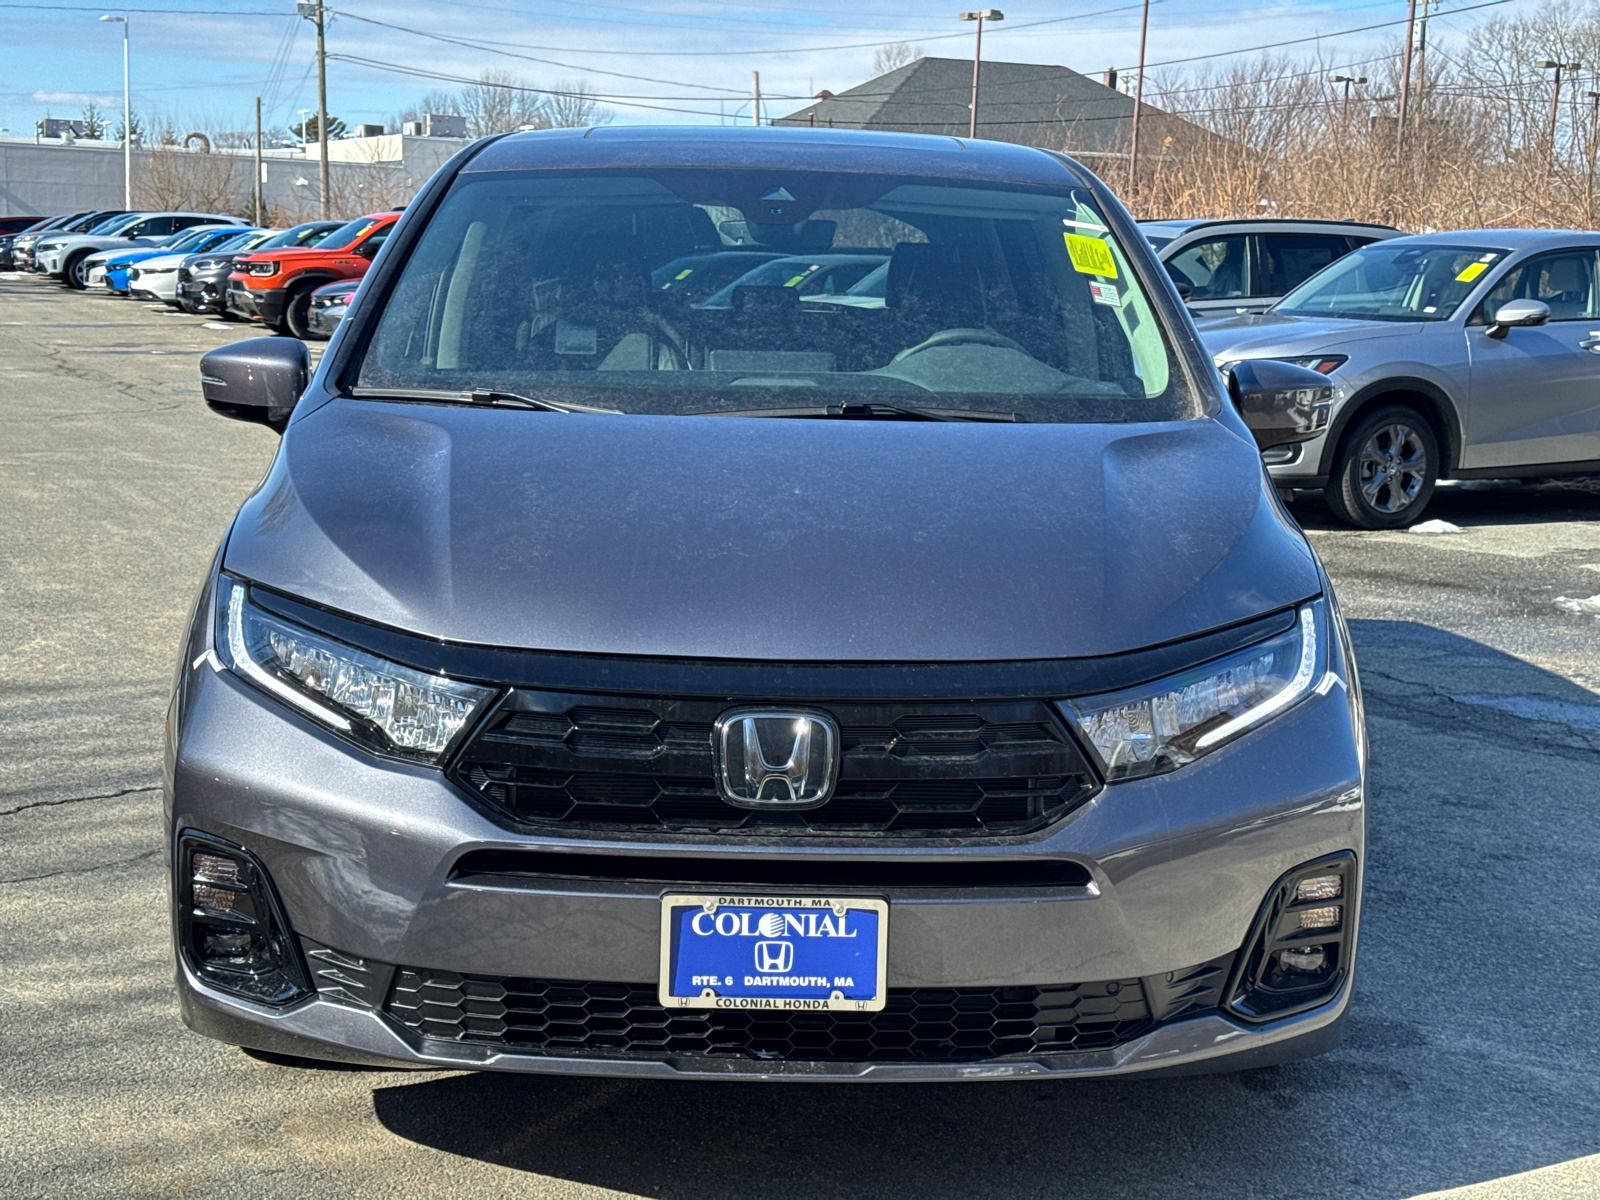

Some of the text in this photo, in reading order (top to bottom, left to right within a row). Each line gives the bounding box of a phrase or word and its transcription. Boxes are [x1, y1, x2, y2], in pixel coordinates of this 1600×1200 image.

[811, 899, 831, 907] MA
[691, 912, 857, 938] COLONIAL
[692, 976, 854, 988] RTE. 6 DARTMOUTH, MA
[715, 998, 830, 1009] COLONIAL HONDA
